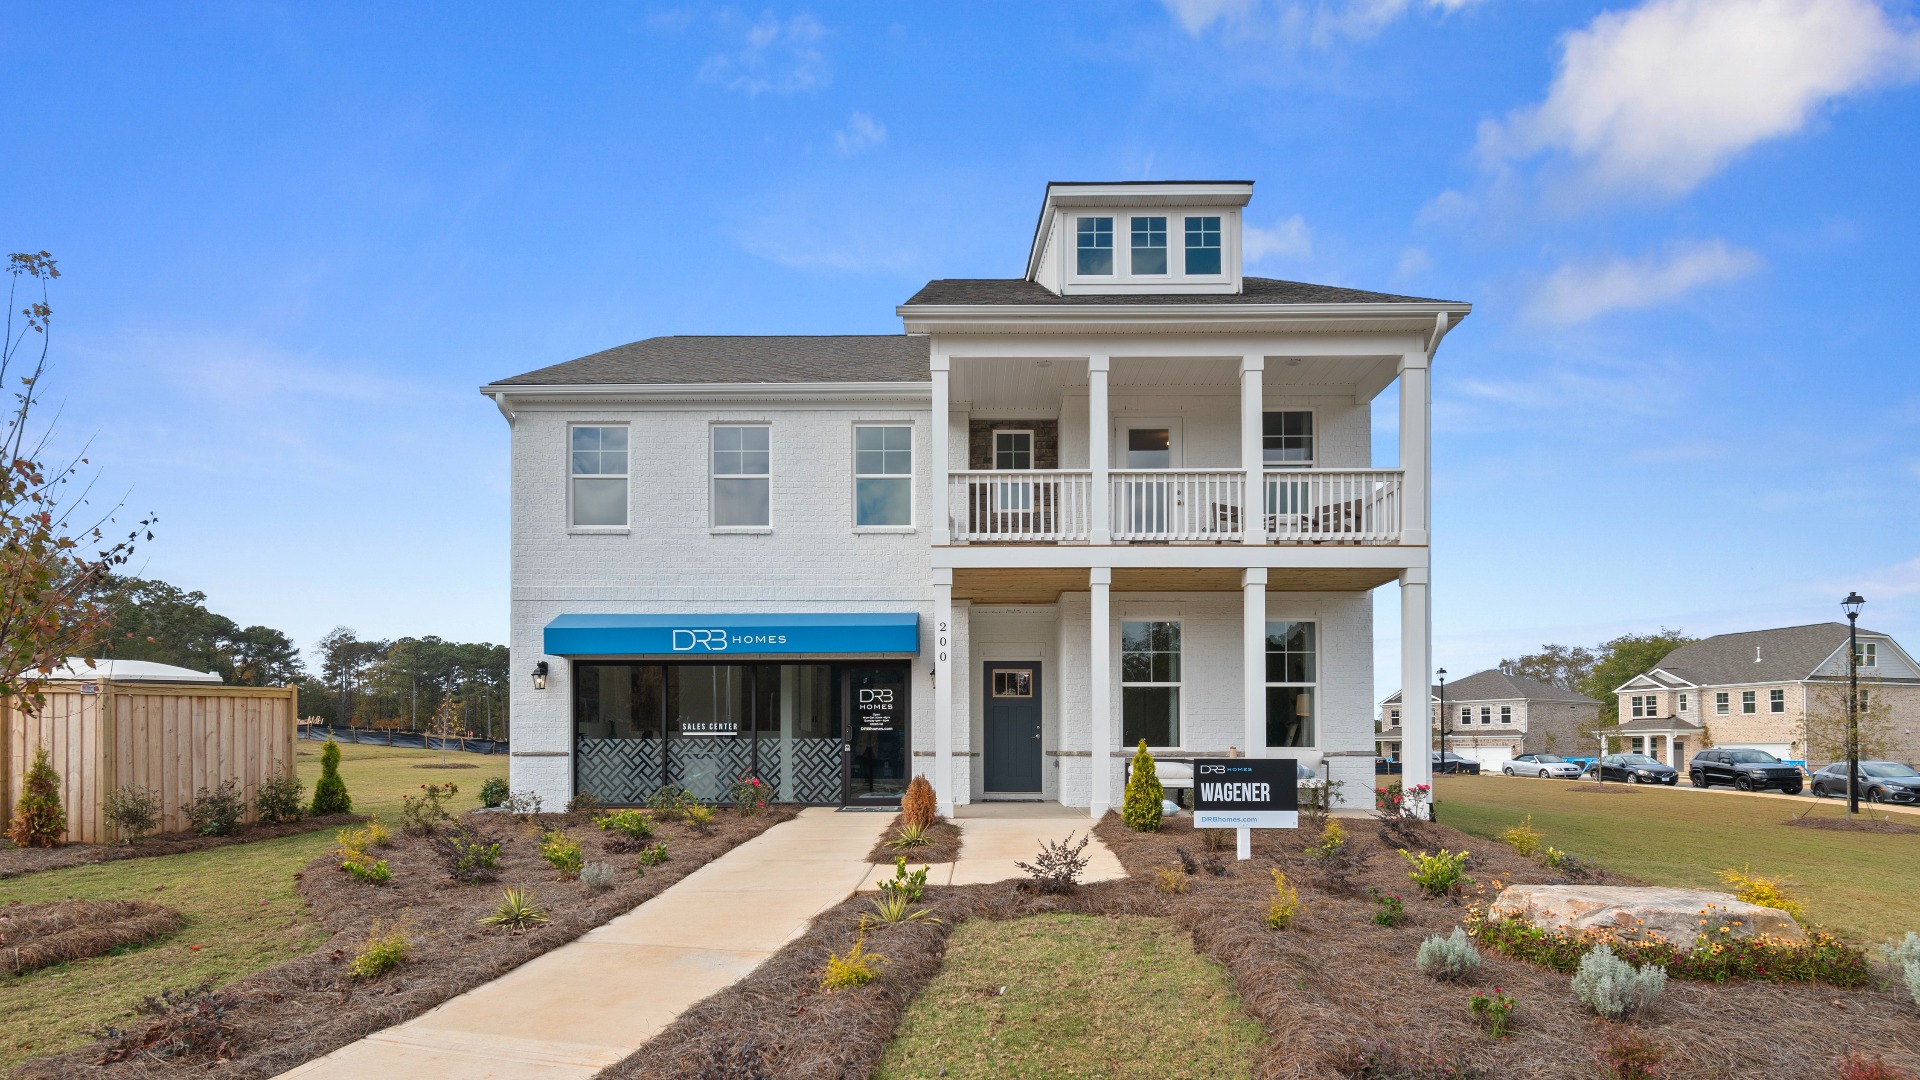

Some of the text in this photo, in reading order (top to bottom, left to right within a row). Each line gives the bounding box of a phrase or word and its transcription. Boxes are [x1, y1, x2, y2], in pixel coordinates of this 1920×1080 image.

[672, 629, 787, 651] DRB HOMES
[859, 689, 894, 703] DRB
[682, 722, 738, 731] SALES CENTER
[1200, 765, 1226, 774] DRB
[1200, 782, 1271, 802] WAGENER
